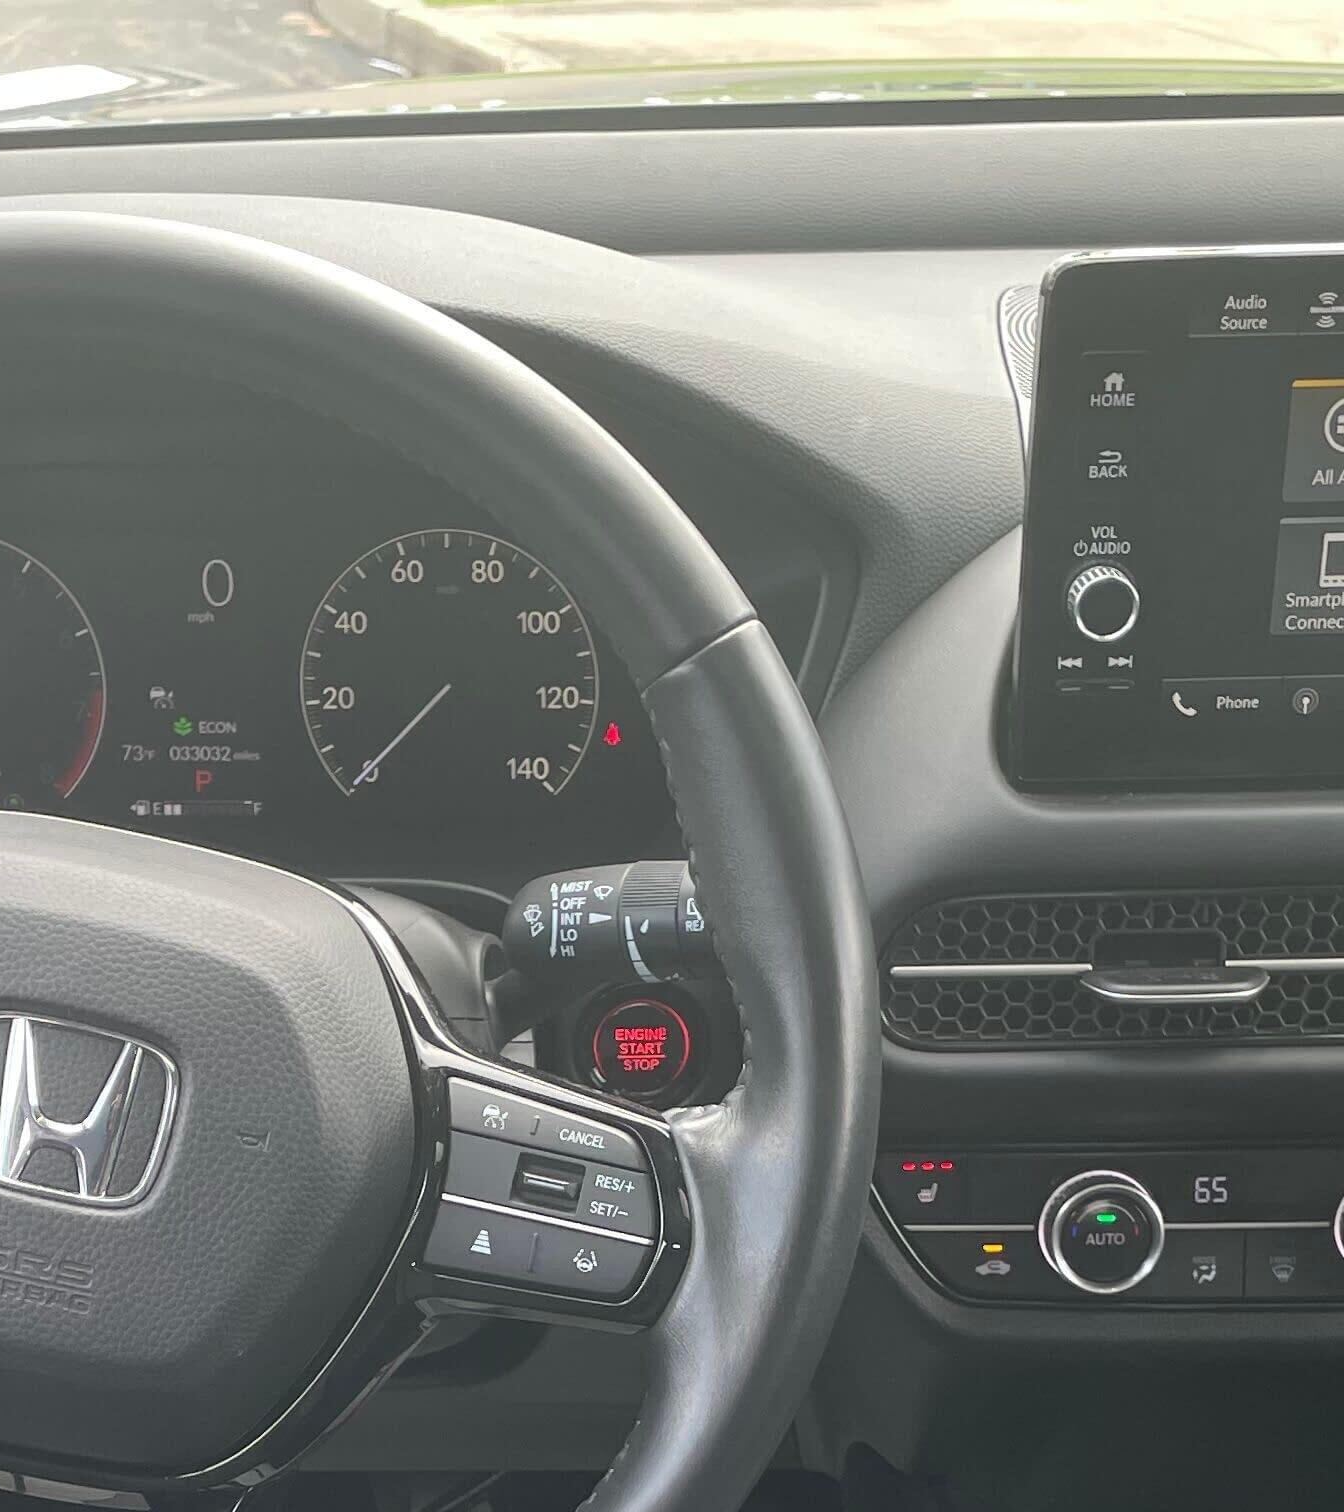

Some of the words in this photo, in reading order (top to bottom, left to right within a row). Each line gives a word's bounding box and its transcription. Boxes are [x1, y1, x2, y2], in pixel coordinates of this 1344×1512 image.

[1223, 294, 1268, 311] Audio
[1219, 315, 1268, 331] Source
[1089, 392, 1136, 408] HOME
[1088, 464, 1128, 479] BACK
[1311, 469, 1334, 486] All
[1090, 526, 1118, 540] VOL
[1089, 540, 1131, 555] AUDIO
[390, 560, 425, 584] 60
[470, 560, 505, 584] 80
[201, 558, 235, 608] 0
[187, 611, 215, 625] mph
[333, 611, 368, 635] 40
[516, 611, 561, 635] 100
[322, 685, 355, 710] 20
[535, 685, 580, 710] 120
[1215, 695, 1260, 711] Phone
[198, 720, 237, 735] ECON
[168, 745, 232, 762] 033032
[506, 756, 550, 781] 140
[194, 769, 214, 793] P
[560, 880, 593, 893] MIST
[560, 897, 586, 910] OFF
[560, 912, 583, 925] INT
[560, 928, 578, 942] LO
[560, 945, 575, 957] HI
[614, 1027, 668, 1042] ENGINE
[618, 1042, 664, 1056] START
[623, 1058, 660, 1071] STOP
[559, 1127, 605, 1150] CANCEL
[594, 1174, 636, 1193] RES/+
[1193, 1176, 1229, 1204] 65
[1085, 1232, 1126, 1247] AUTO
